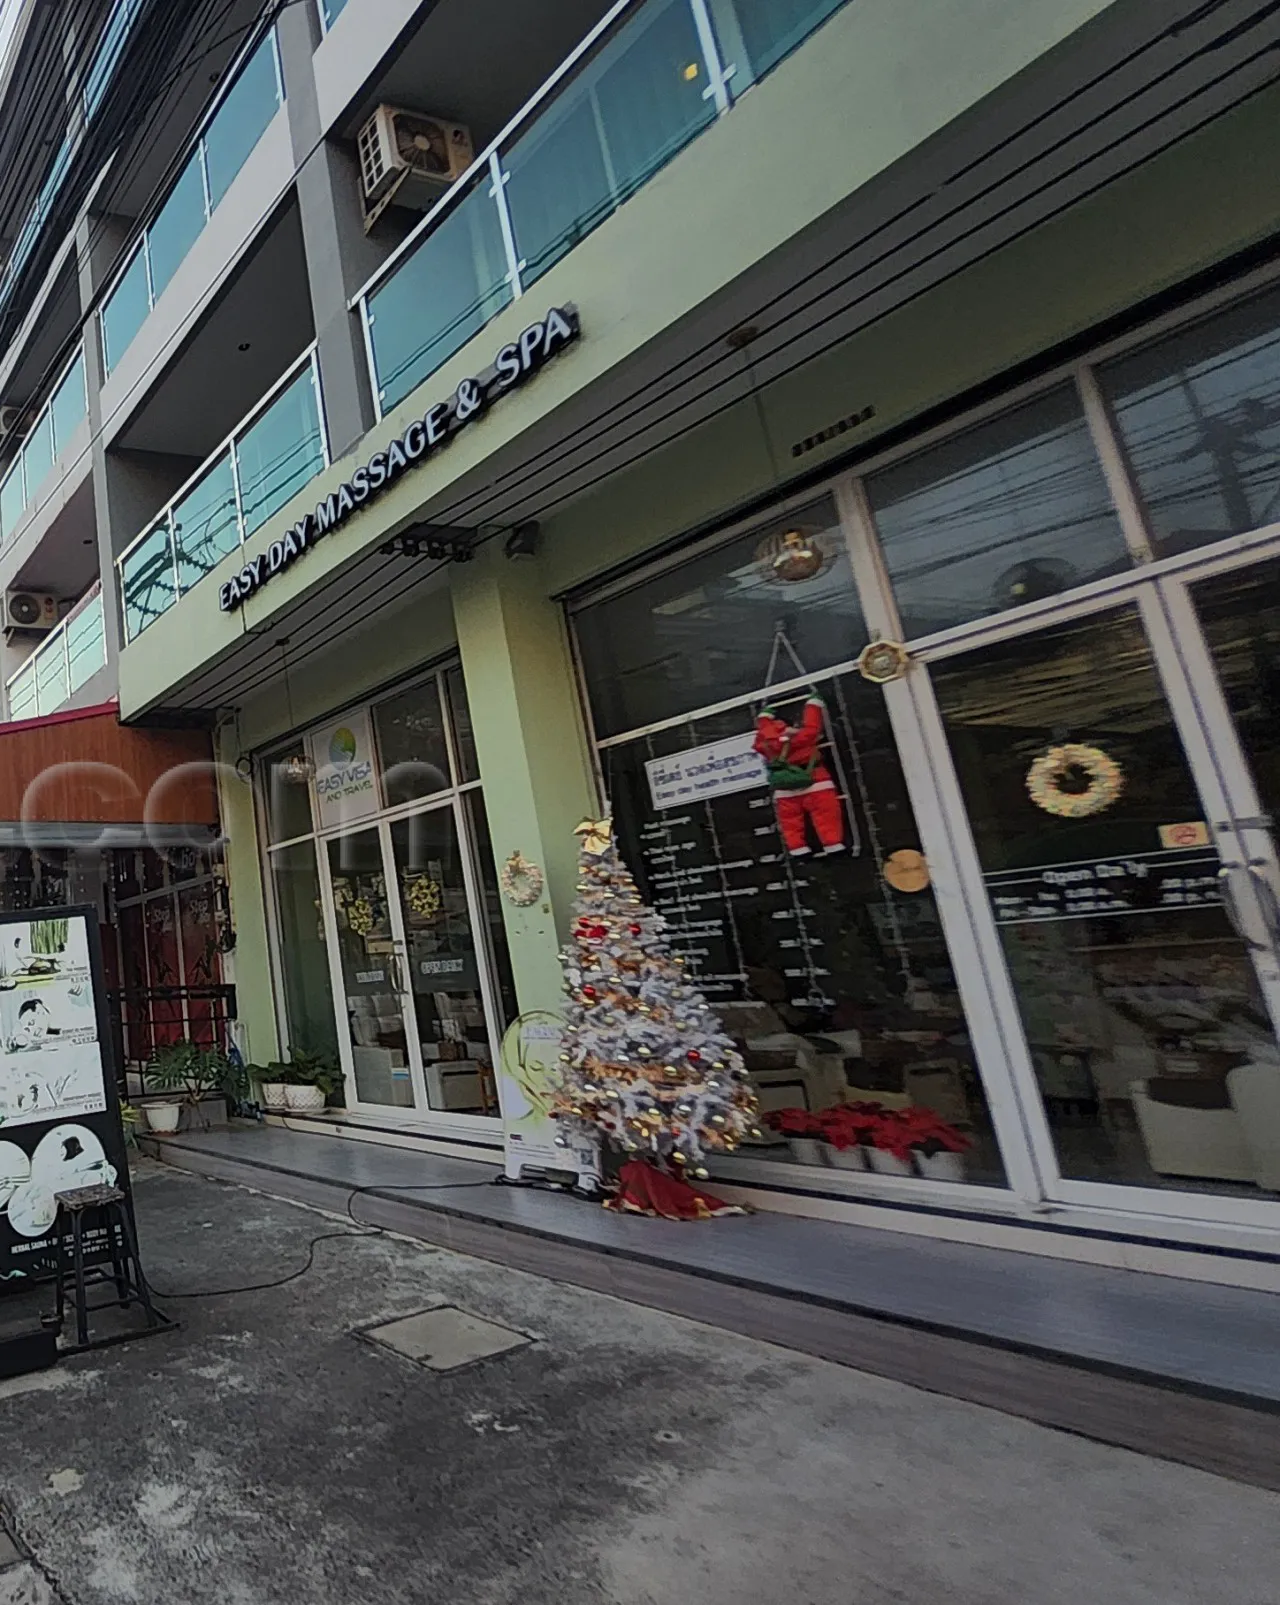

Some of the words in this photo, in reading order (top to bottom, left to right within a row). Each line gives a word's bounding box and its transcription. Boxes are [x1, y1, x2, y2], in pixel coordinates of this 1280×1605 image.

[218, 557, 266, 612] EASY
[266, 515, 311, 573] DAY
[315, 402, 449, 535] MASSAGE
[456, 378, 483, 420] &
[495, 307, 576, 387] SPA
[317, 771, 346, 794] EASY
[346, 761, 372, 782] VISA
[326, 792, 342, 804] AND
[343, 780, 373, 796] TRAVEL
